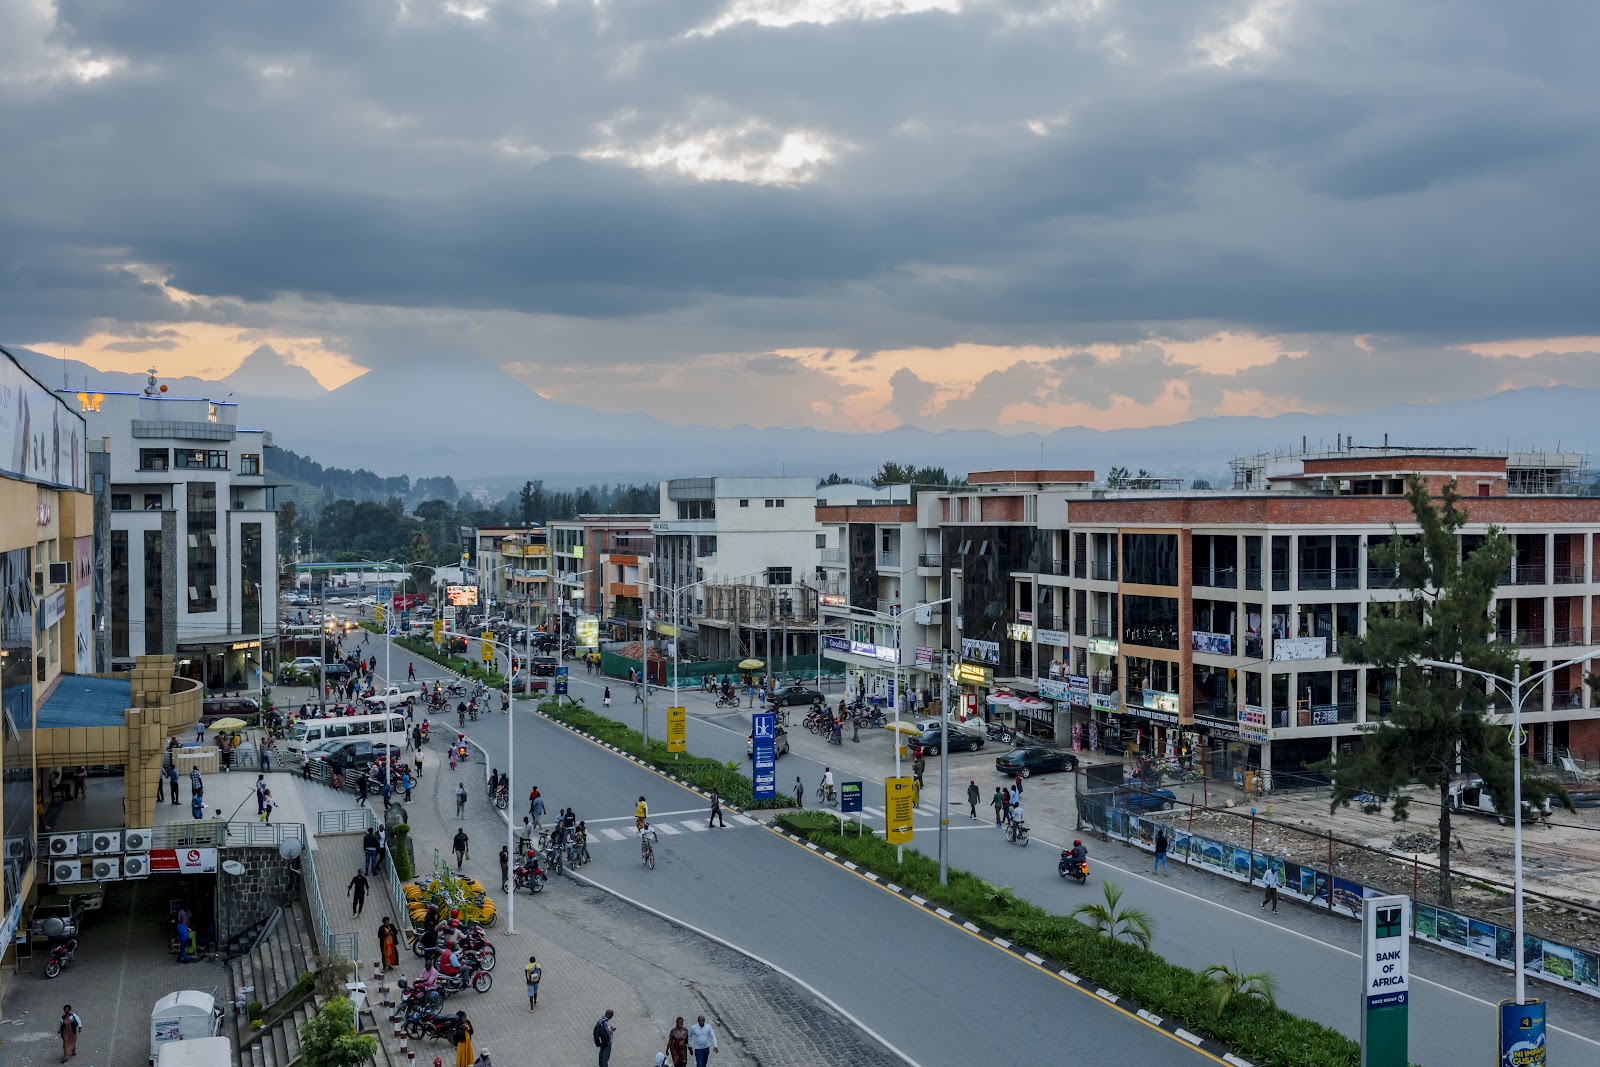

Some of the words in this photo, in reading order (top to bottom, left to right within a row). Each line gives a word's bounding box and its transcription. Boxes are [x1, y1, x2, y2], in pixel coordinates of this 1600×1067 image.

[829, 639, 849, 650] GoodLife
[1019, 709, 1052, 722] SAMSUNG
[1376, 950, 1400, 962] BANK
[1382, 964, 1394, 973] OF
[1372, 975, 1404, 988] AFRICA
[1512, 1057, 1535, 1066] GUSA
